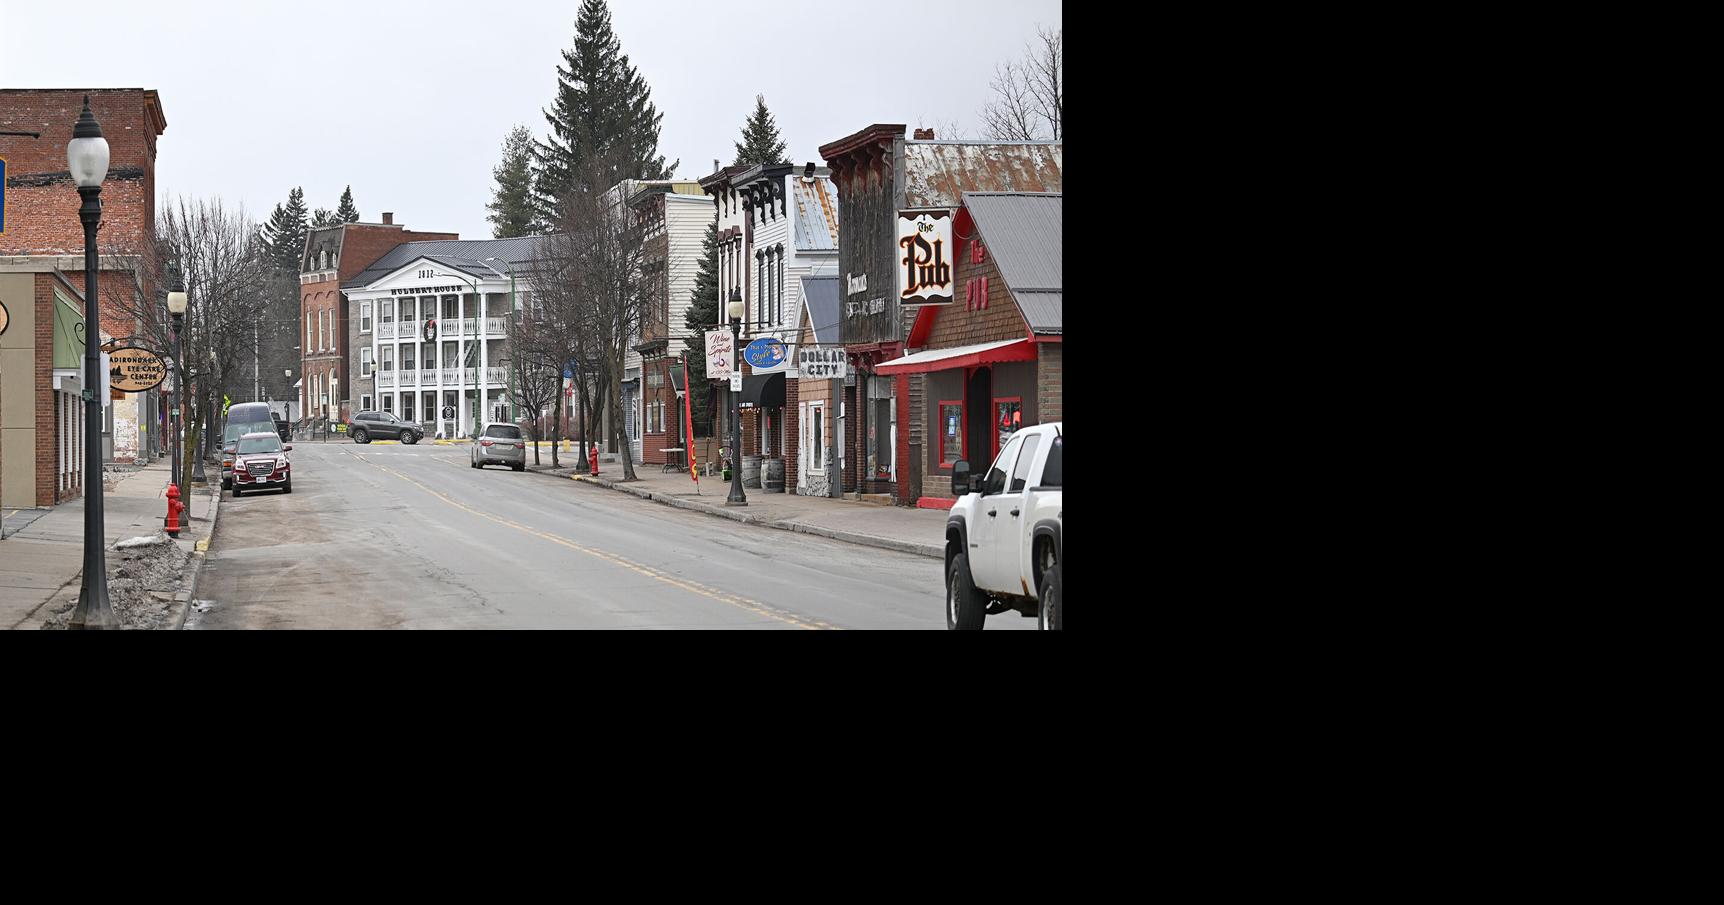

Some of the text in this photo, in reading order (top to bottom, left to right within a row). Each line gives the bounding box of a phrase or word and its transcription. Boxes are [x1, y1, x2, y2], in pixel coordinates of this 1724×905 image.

[917, 221, 934, 233] The
[900, 232, 951, 296] Pub
[418, 270, 434, 278] 1812
[965, 276, 989, 312] PUB
[710, 333, 730, 344] Wine
[708, 344, 732, 358] Spirits
[800, 350, 845, 363] DOLLAR
[808, 364, 838, 376] CITY
